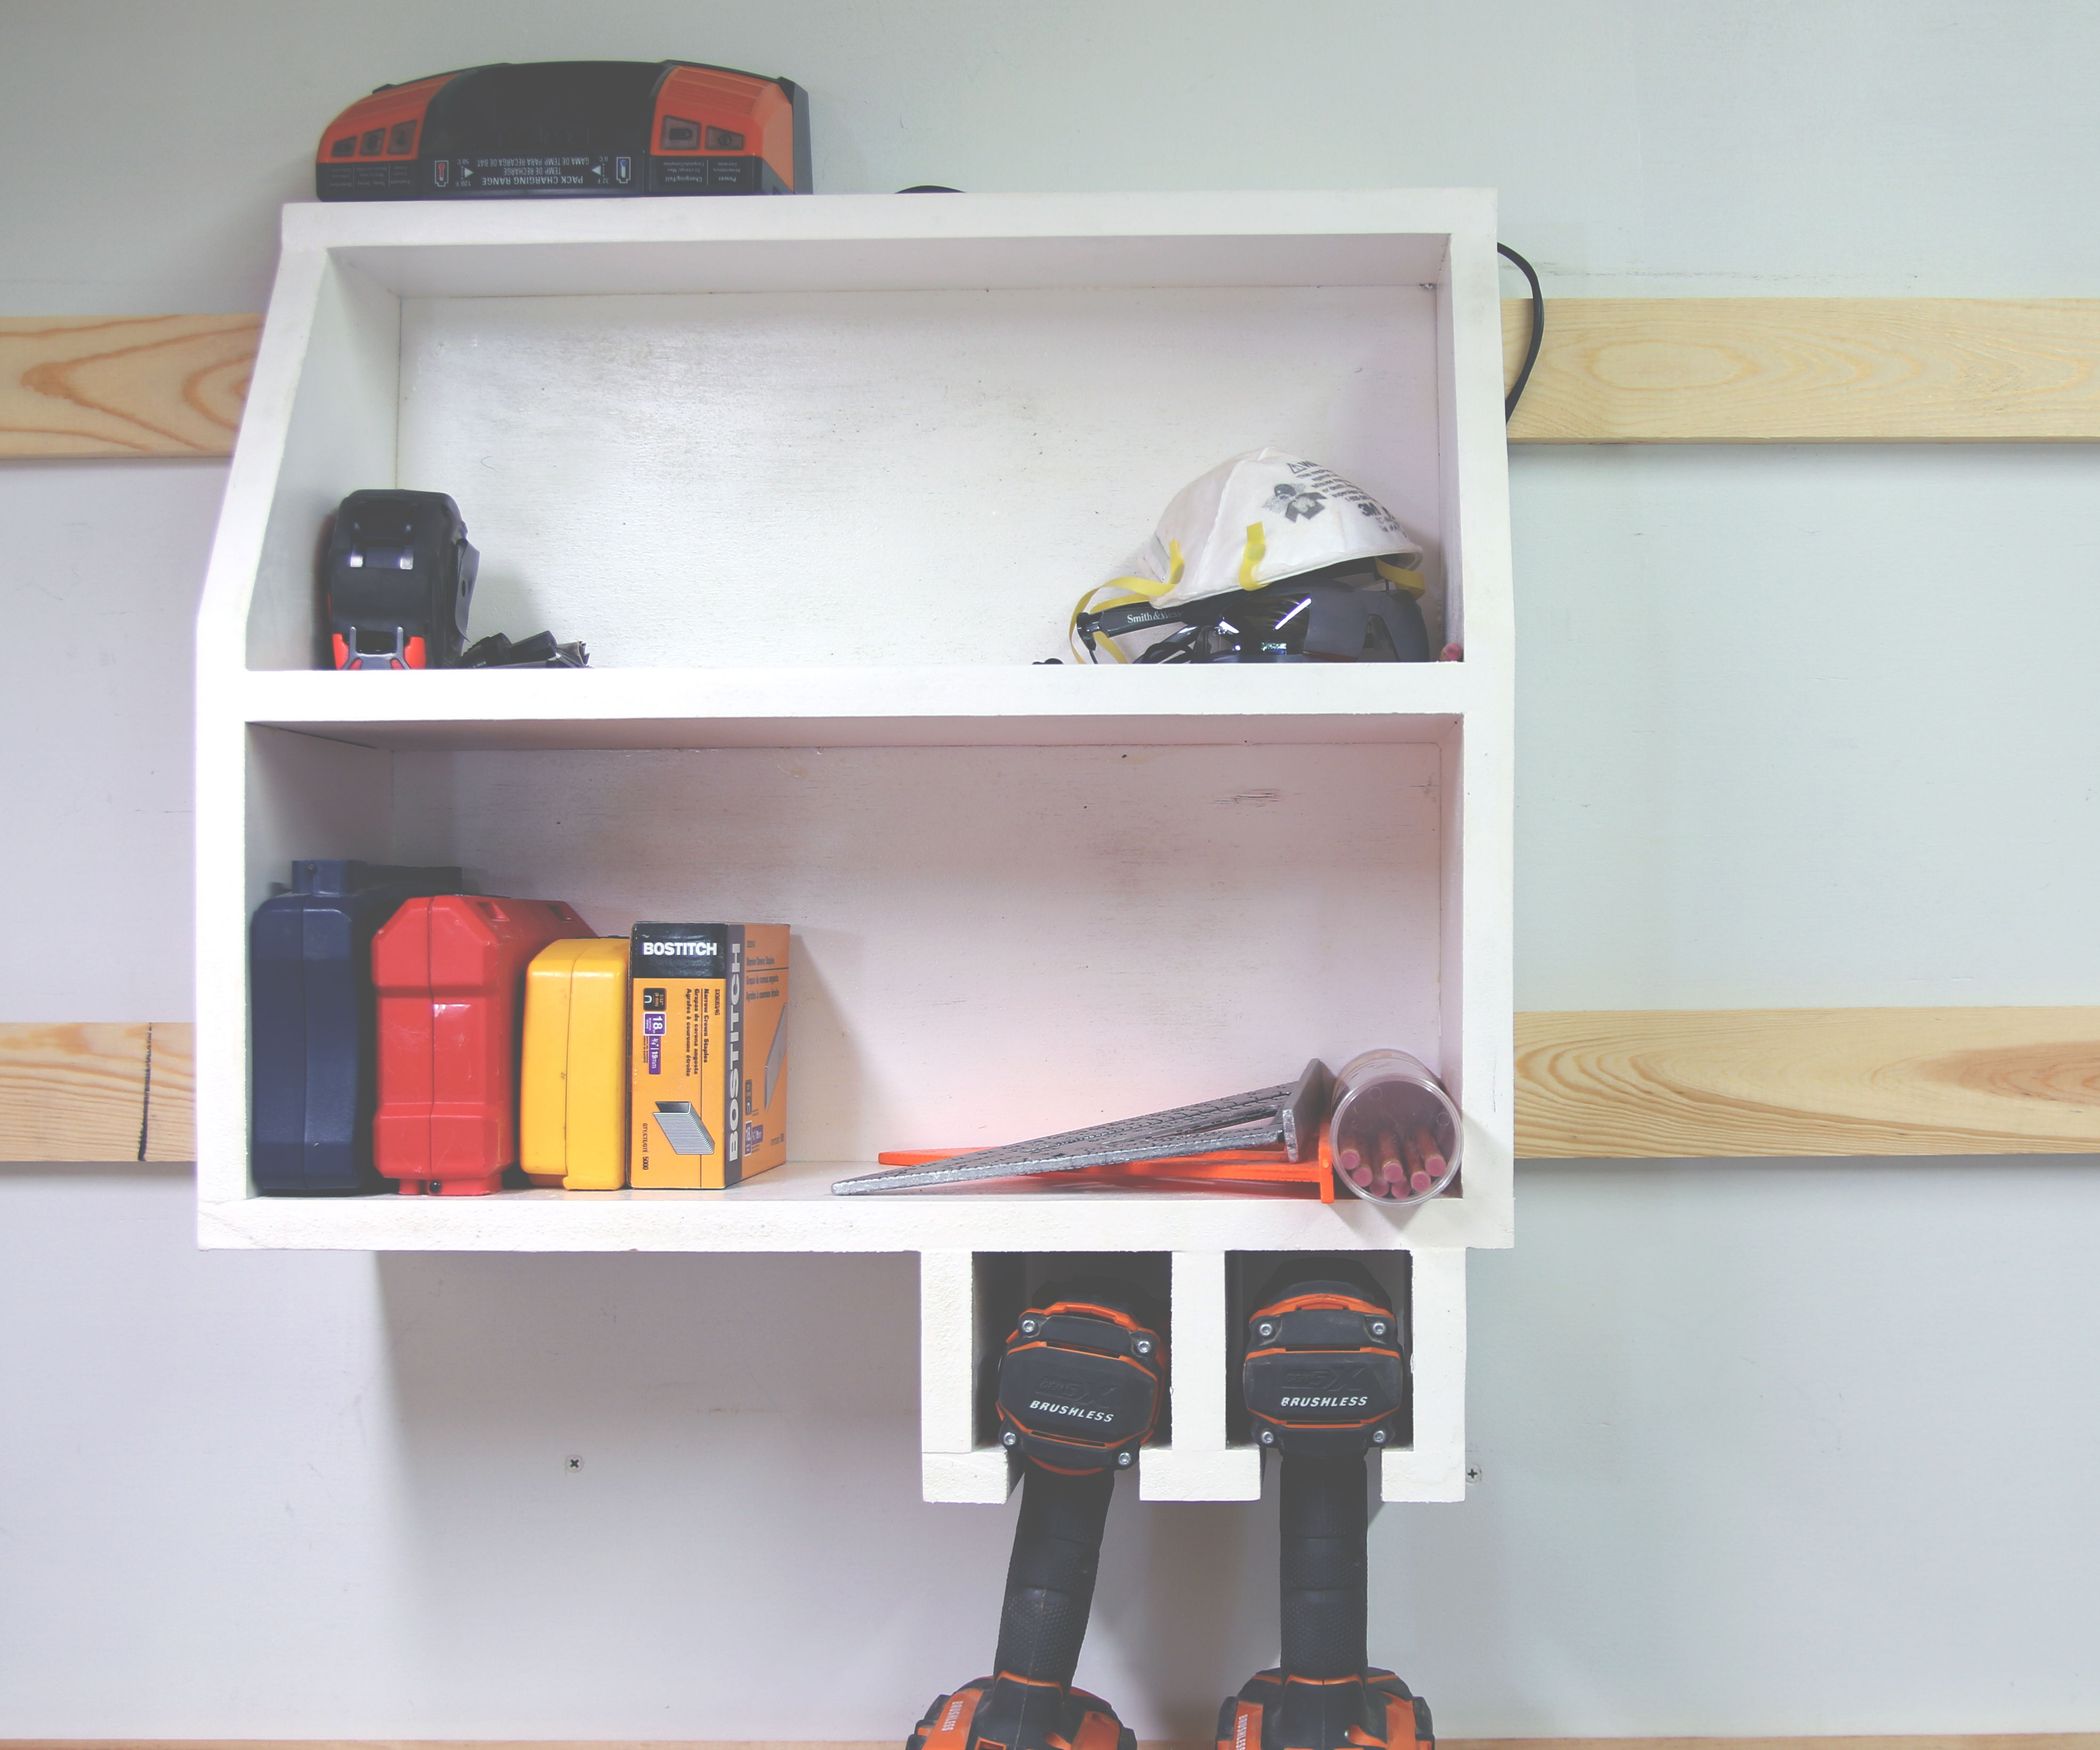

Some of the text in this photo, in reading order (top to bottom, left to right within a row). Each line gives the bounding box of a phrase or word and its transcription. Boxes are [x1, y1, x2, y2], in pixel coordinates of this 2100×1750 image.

[489, 159, 497, 167] DE
[498, 158, 526, 167] RECARGA
[526, 158, 543, 166] PARA
[561, 157, 570, 165] DE
[571, 157, 589, 165] GAMA
[503, 168, 534, 176] RECHARGE
[535, 167, 543, 175] DE
[482, 175, 584, 185] PACK CHARGING RANGE
[642, 941, 717, 957] BOSTITCH
[728, 942, 742, 1163] BOSTITCH
[1280, 1396, 1369, 1408] BRUSHLESS
[1028, 1399, 1115, 1423] BRUSHLESS
